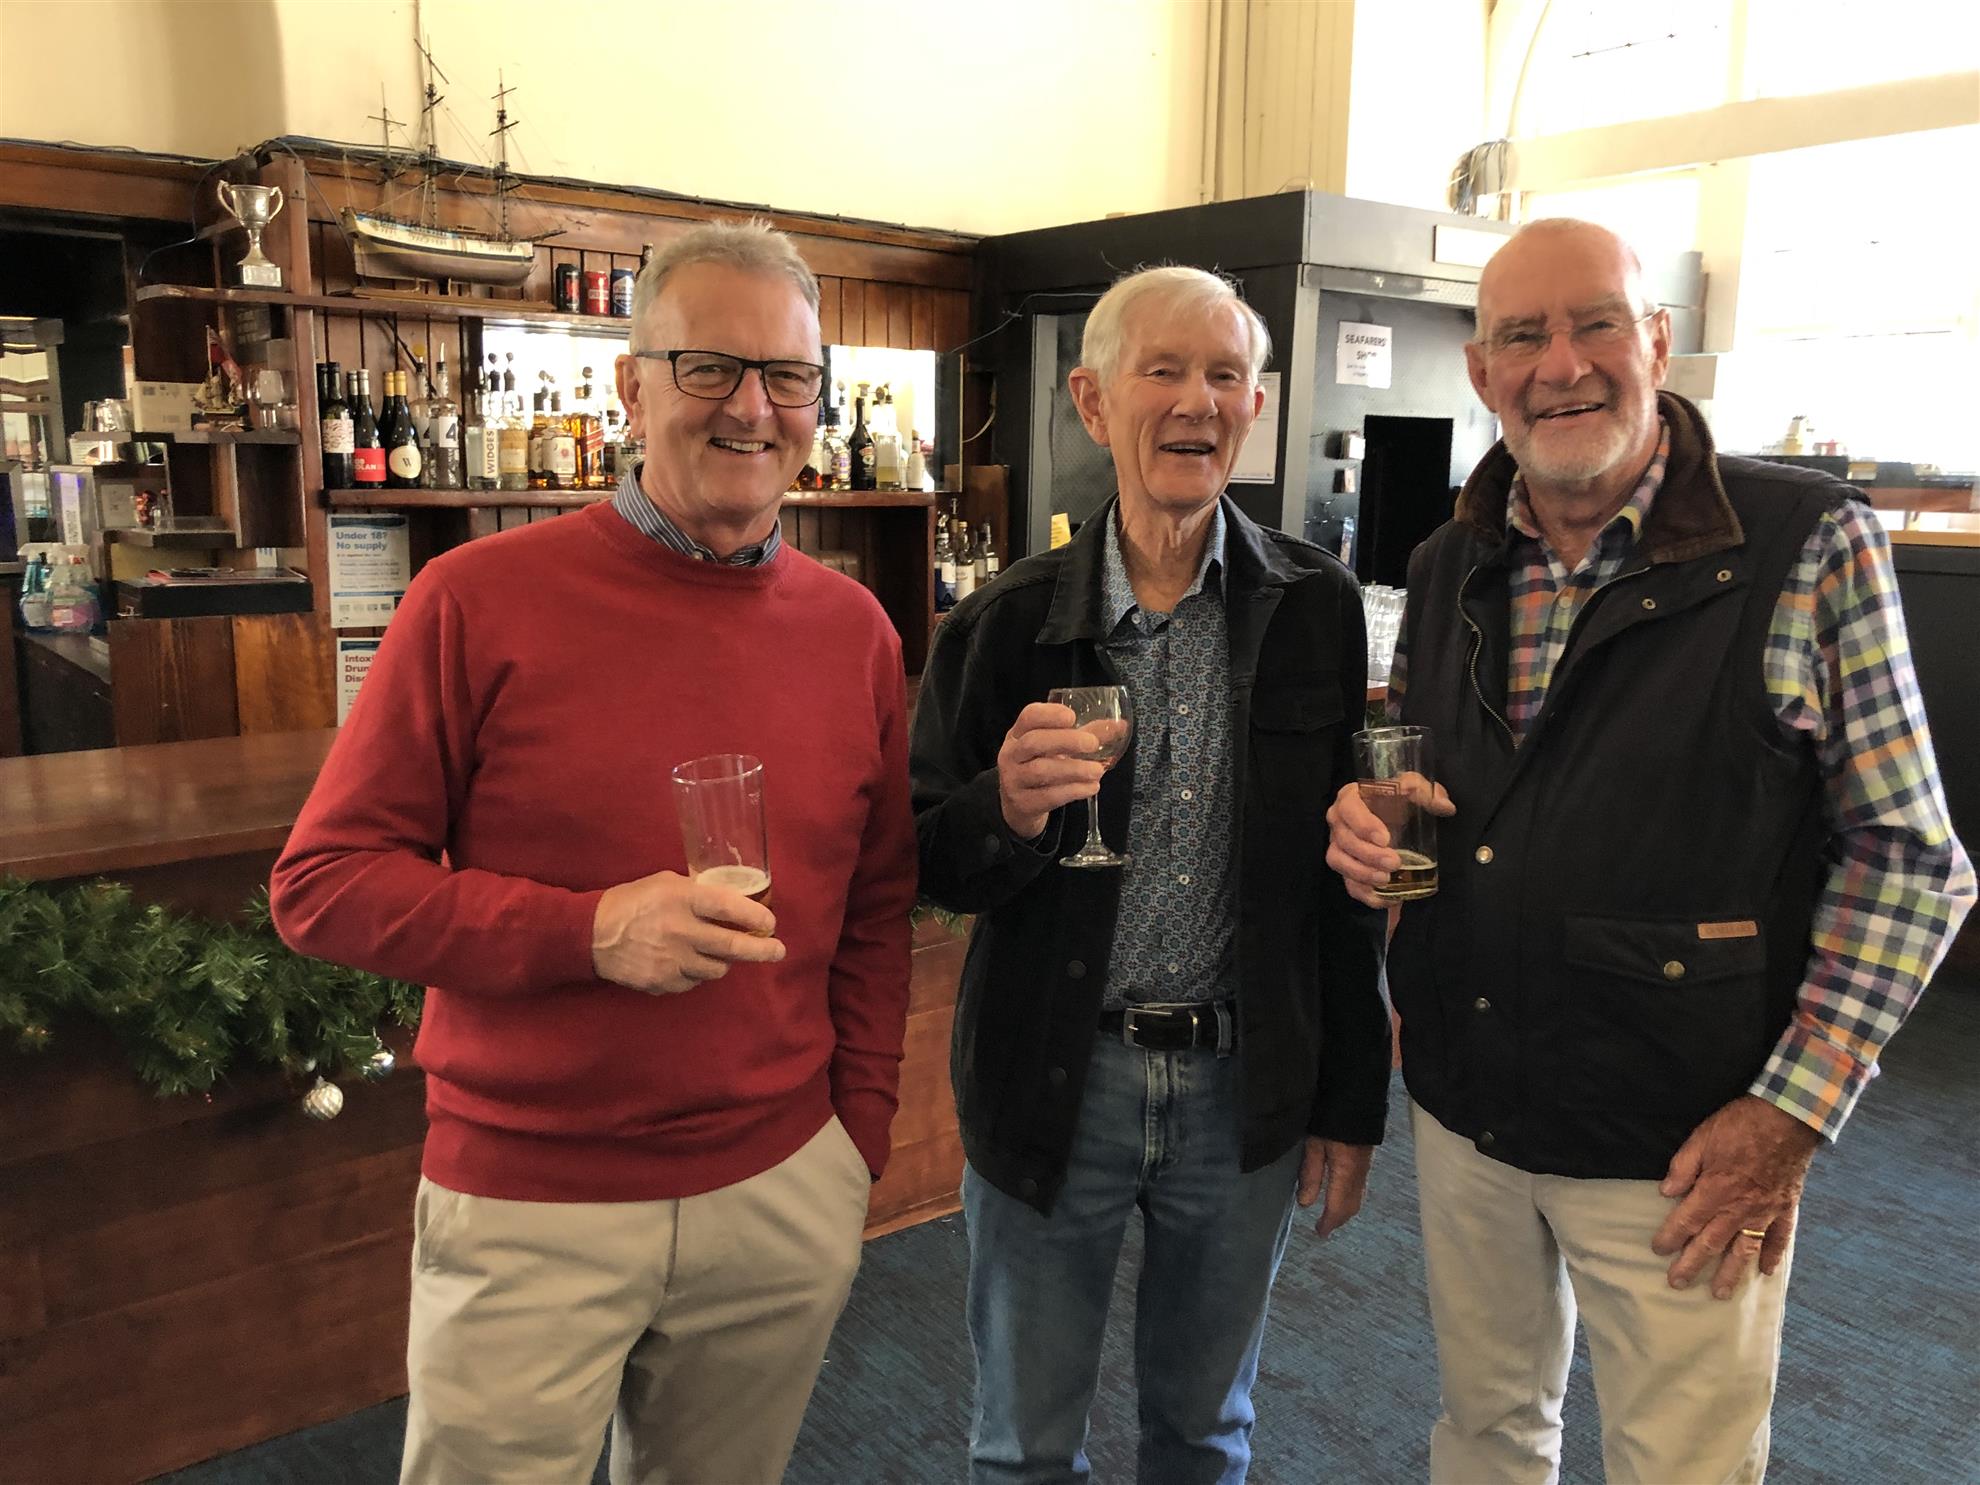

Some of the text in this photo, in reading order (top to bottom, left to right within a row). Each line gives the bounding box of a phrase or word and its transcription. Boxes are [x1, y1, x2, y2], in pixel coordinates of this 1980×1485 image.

[446, 422, 456, 441] 4
[336, 532, 367, 540] Under
[336, 541, 387, 551] No supply
[345, 664, 370, 673] Drun
